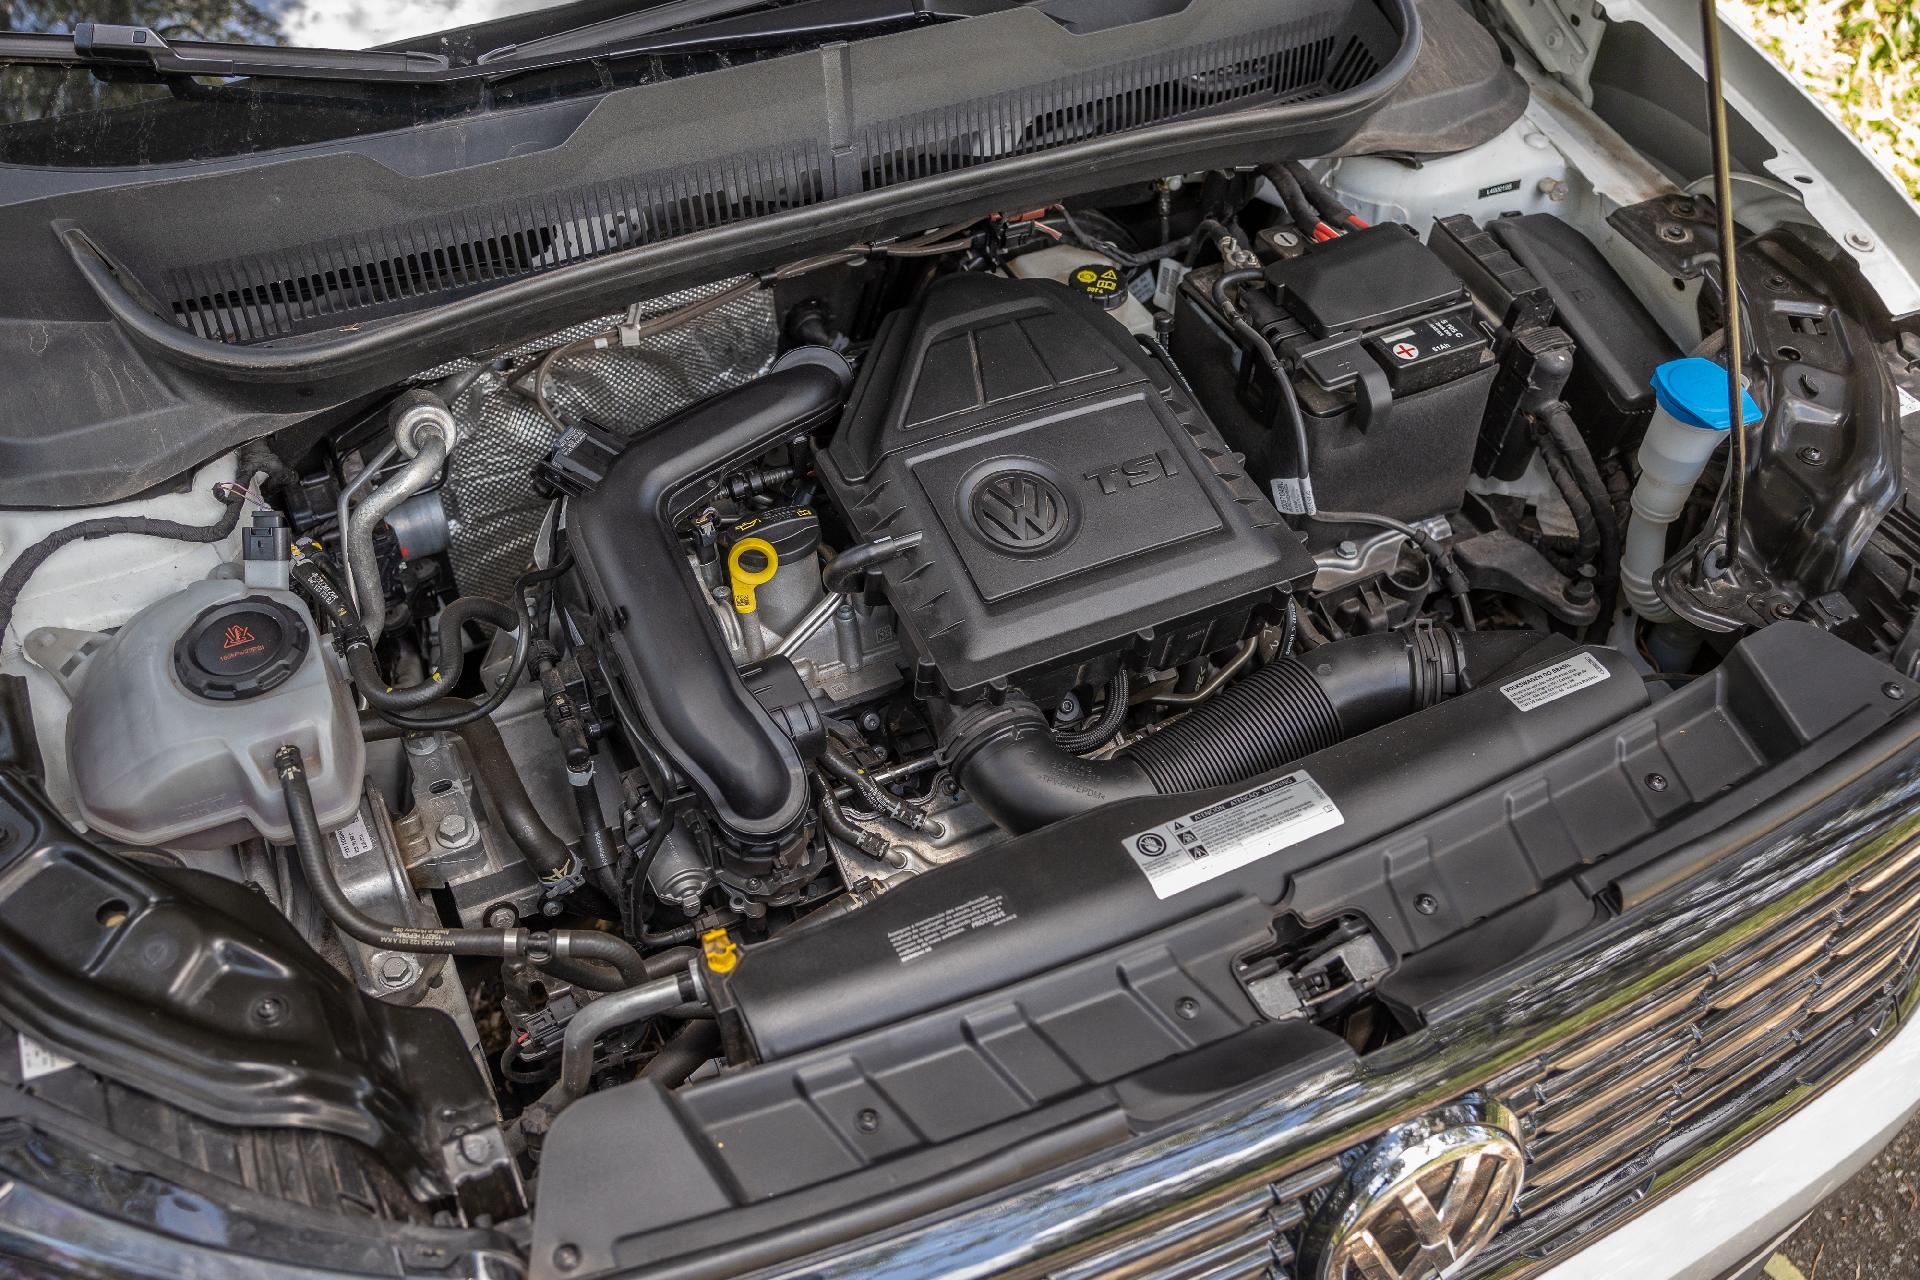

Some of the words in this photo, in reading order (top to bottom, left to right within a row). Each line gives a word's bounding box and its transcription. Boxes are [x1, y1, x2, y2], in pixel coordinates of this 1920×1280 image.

[1084, 451, 1179, 495] TSI
[1503, 674, 1544, 693] VOLKSWAGEN
[1543, 669, 1552, 679] DO
[1551, 662, 1572, 674] BRASIL
